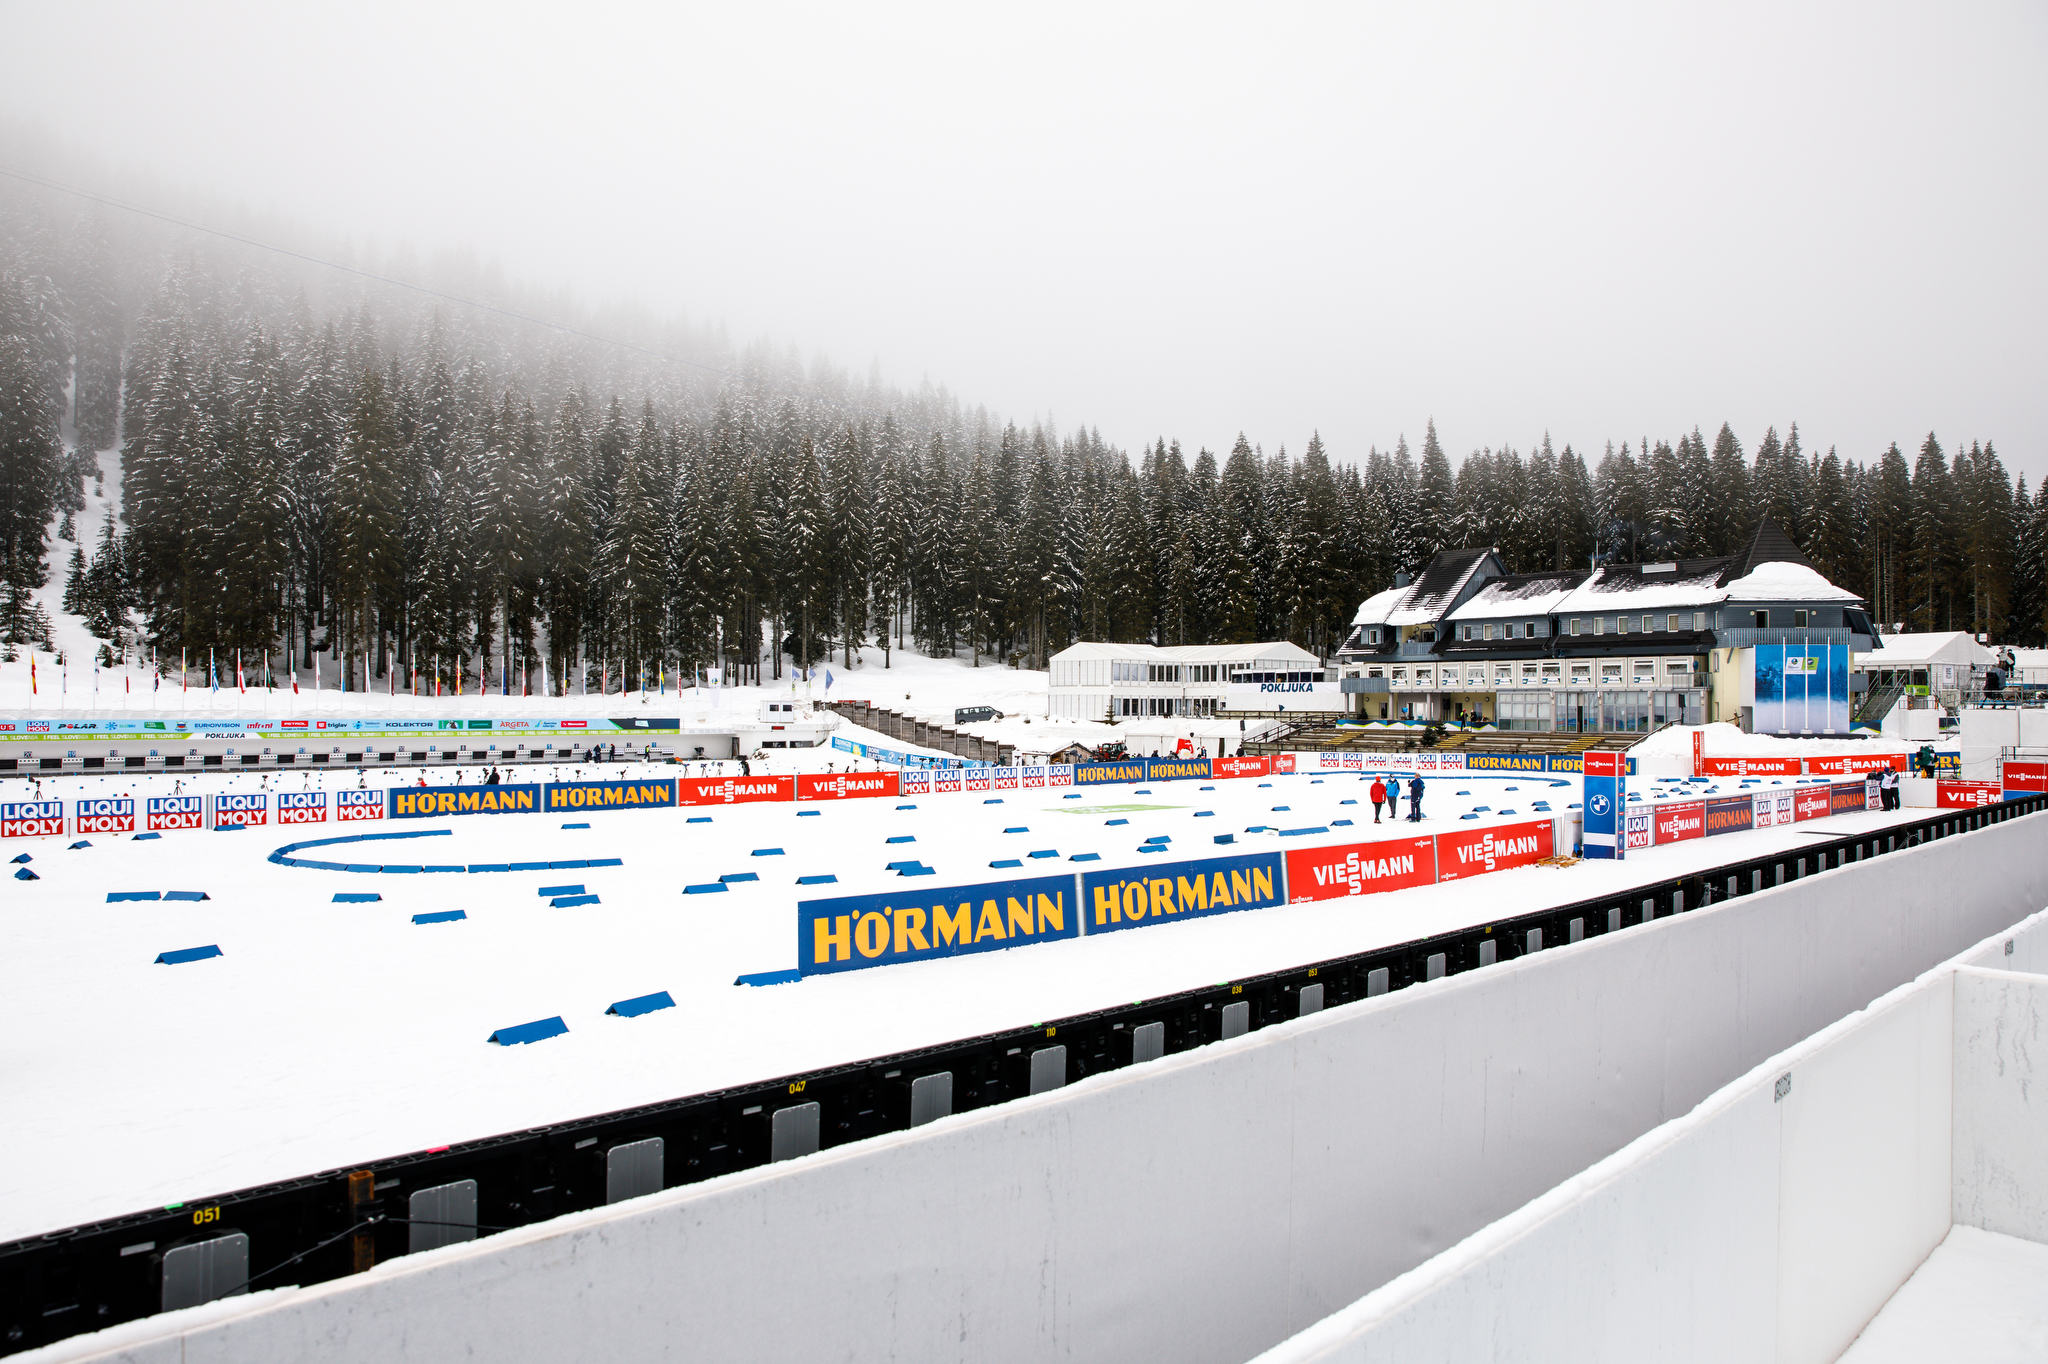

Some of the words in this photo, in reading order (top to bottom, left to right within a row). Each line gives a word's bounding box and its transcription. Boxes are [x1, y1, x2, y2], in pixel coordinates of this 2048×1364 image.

[1261, 683, 1313, 692] POKLJUKA
[1150, 762, 1208, 778] HÖRMANN
[1222, 760, 1261, 775] VIESSMANN
[1344, 760, 1362, 768] MOLY
[1469, 756, 1541, 770] HÖRMANN
[1716, 760, 1784, 775] VIESSMANN
[1819, 758, 1890, 774] VIESSMANN
[904, 772, 928, 783] LIQUI
[936, 770, 960, 782] LIQUI
[966, 769, 989, 780] LIQUI
[996, 768, 1017, 779] LIQUI
[1023, 767, 1044, 778] LIQUI
[1050, 766, 1070, 776] LIQUI
[1078, 766, 1142, 782] HÖRMANN
[813, 776, 884, 797] VIESSMANN
[904, 783, 930, 794] MOLY
[936, 782, 961, 792] MOLY
[966, 780, 990, 790] MOLY
[996, 778, 1018, 788] MOLY
[1023, 777, 1044, 787] MOLY
[1050, 776, 1071, 786] MOLY
[551, 785, 670, 807] HÖRMANN
[697, 780, 778, 802] VIESSMANN
[150, 798, 200, 813] LIQUI
[218, 795, 265, 810] LIQUI
[280, 794, 324, 808] LIQUI
[339, 792, 382, 806] LIQUI
[397, 791, 533, 814] HÖRMANN
[1832, 792, 1865, 808] HÖRMANN
[4, 802, 60, 819] LIQUI
[79, 800, 132, 816] LIQUI
[339, 806, 382, 820] MOLY
[1798, 797, 1828, 817] VIESSMANN
[150, 813, 200, 830] MOLY
[218, 810, 266, 825] MOLY
[280, 808, 326, 822] MOLY
[1708, 808, 1752, 830] HÖRMANN
[4, 818, 62, 837] MOLY
[80, 816, 134, 832] MOLY
[1628, 816, 1648, 832] LIQUI
[1660, 815, 1700, 838] VIESSMANN
[1628, 832, 1648, 848] MOLY
[1457, 833, 1538, 870] VIESSMANN
[1314, 852, 1414, 895] VIESSMANN
[1094, 865, 1274, 926] HÖRMANN
[813, 890, 1064, 964] HÖRMANN
[193, 1206, 220, 1225] 051
